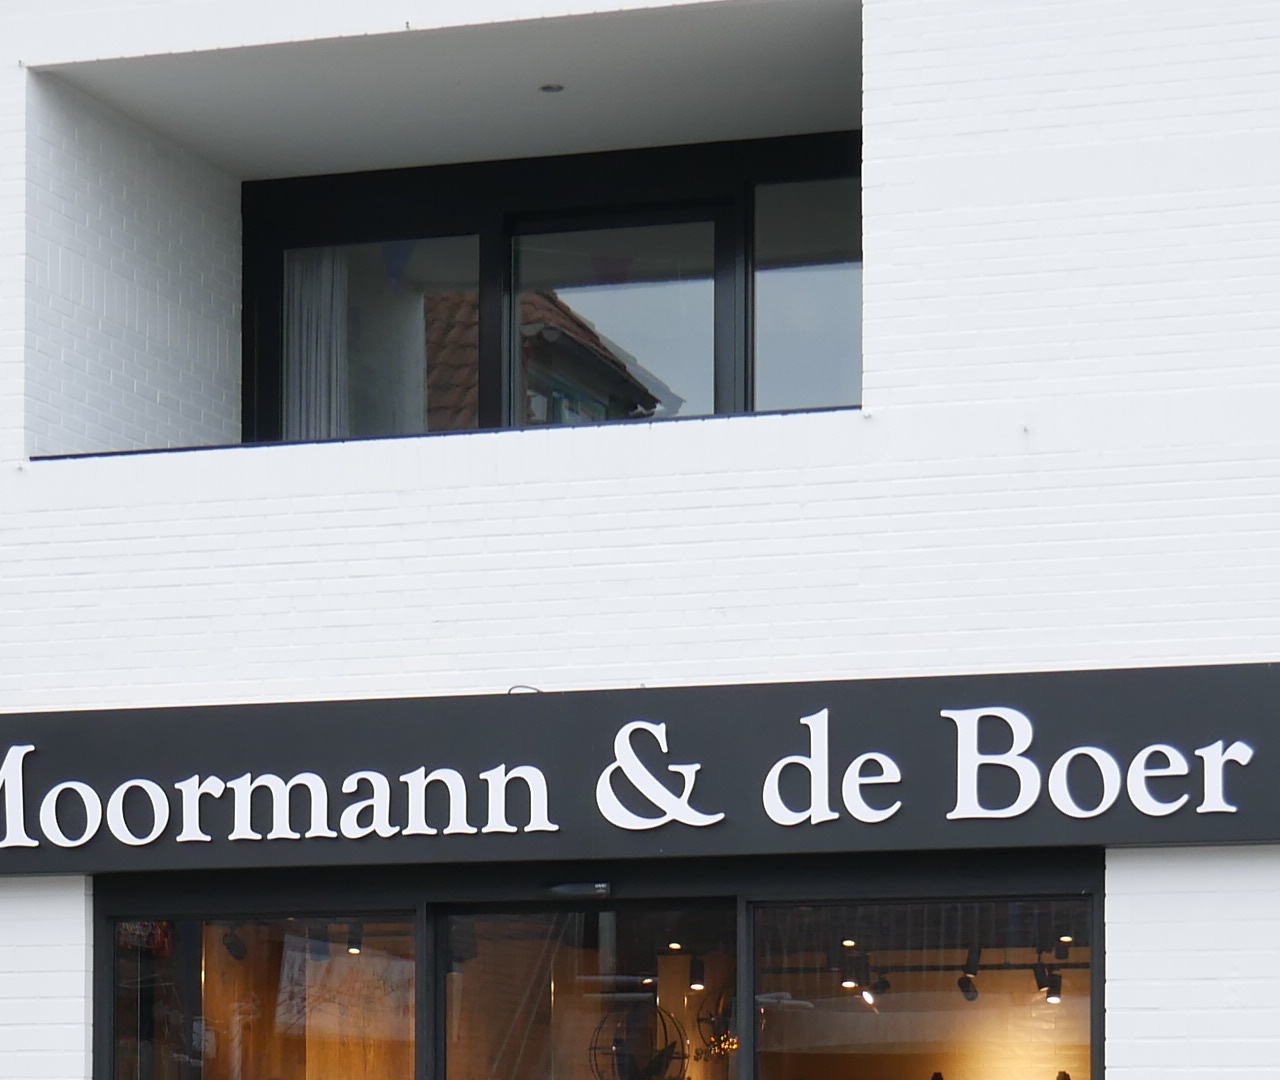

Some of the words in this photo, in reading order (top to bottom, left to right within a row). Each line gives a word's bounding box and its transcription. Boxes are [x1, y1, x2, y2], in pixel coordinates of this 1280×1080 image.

[595, 720, 726, 830] &
[762, 707, 903, 826] de
[939, 706, 1255, 820] Boer
